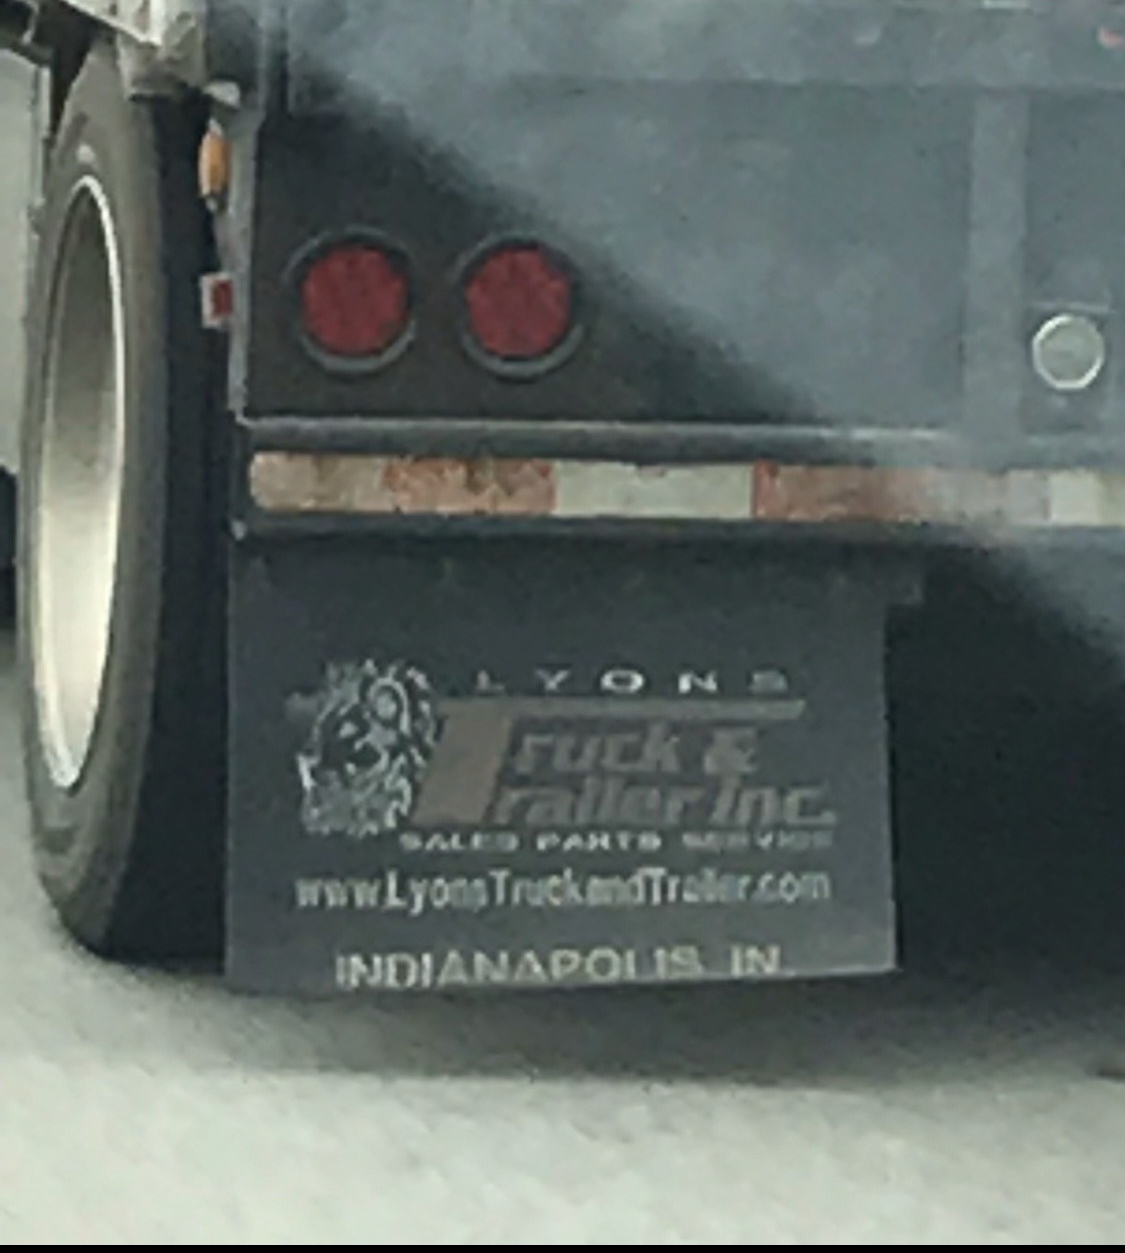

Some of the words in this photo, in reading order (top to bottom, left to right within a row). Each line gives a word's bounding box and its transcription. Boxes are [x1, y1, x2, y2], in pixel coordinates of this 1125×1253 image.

[476, 669, 788, 694] LYONS
[400, 832, 520, 851] SALES
[536, 831, 662, 851] PARTS
